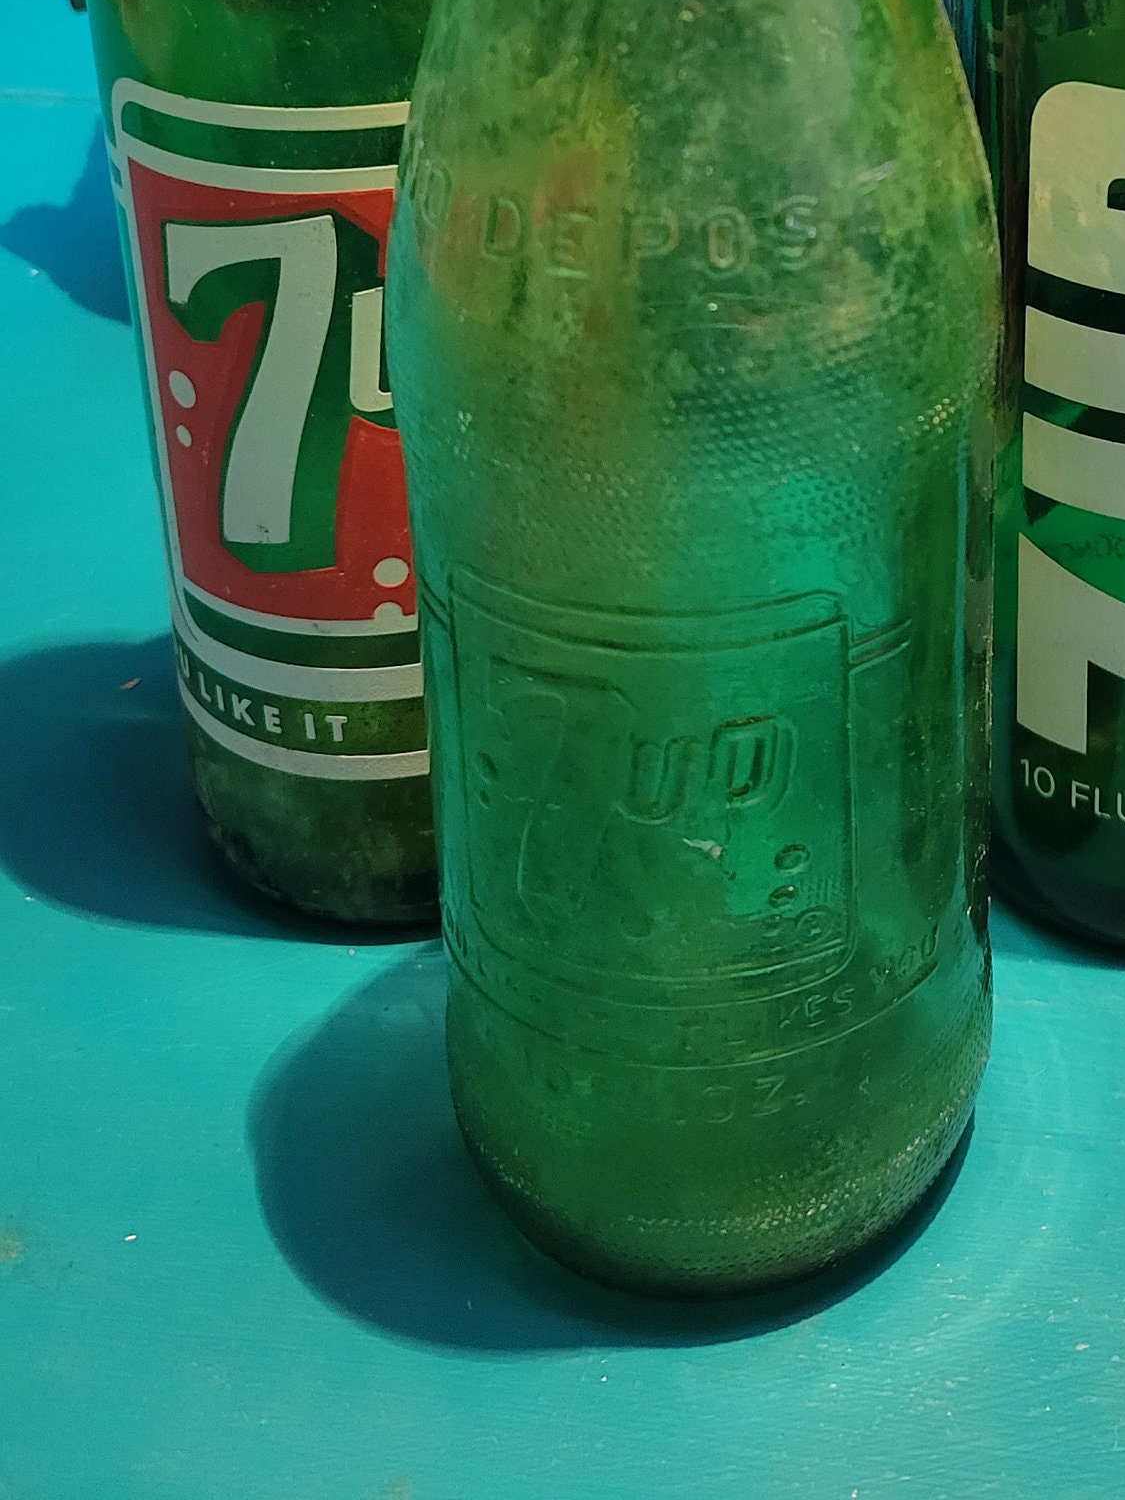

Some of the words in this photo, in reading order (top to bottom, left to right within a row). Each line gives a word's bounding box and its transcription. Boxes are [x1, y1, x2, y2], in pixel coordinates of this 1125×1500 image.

[198, 670, 283, 735] LIKE
[303, 712, 349, 743] IT
[1020, 757, 1056, 798] 10
